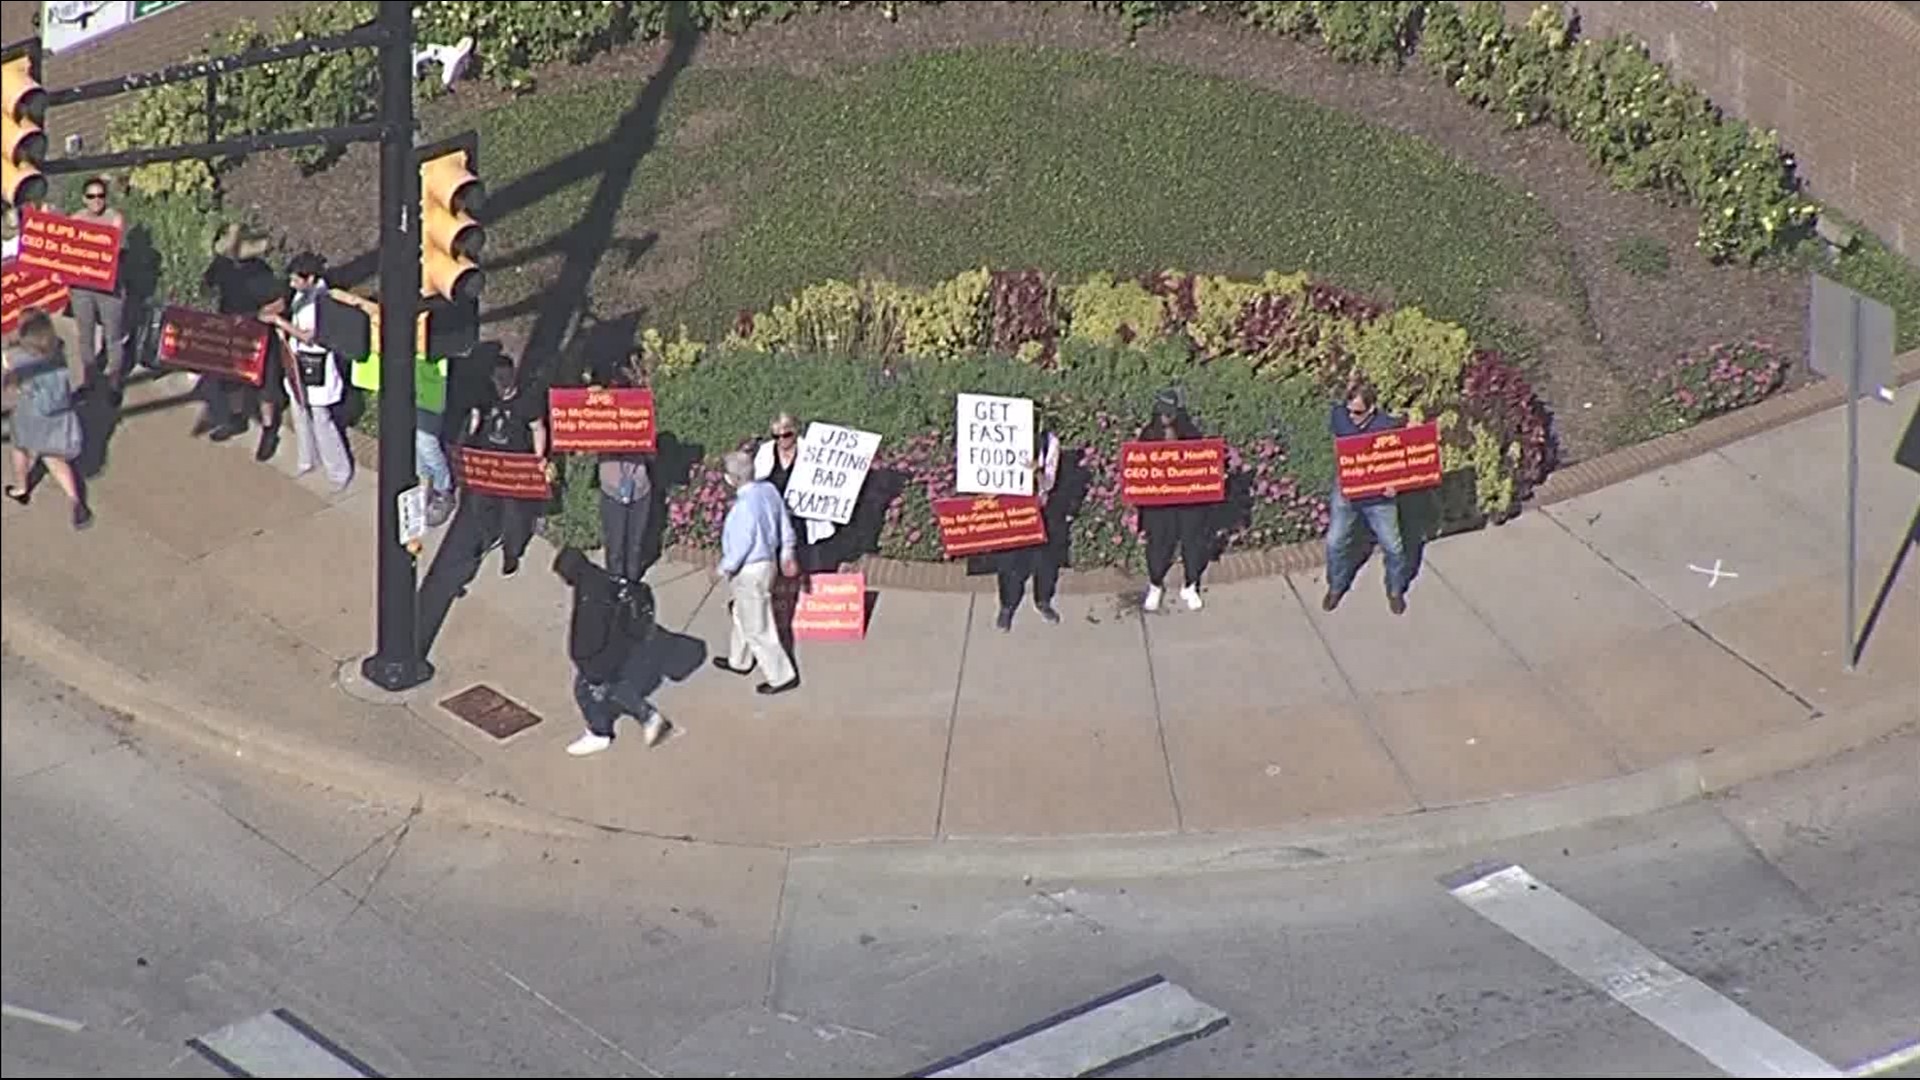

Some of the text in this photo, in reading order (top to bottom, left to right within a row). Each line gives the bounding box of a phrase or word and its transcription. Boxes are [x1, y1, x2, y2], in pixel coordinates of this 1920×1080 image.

[975, 401, 1011, 422] GET
[820, 430, 859, 449] JPS
[970, 423, 1019, 443] FAST
[803, 445, 868, 471] SETTING
[970, 446, 1029, 467] FOODS
[812, 467, 847, 489] BAD
[977, 467, 1025, 491] OUT!
[1123, 467, 1149, 479] CEO
